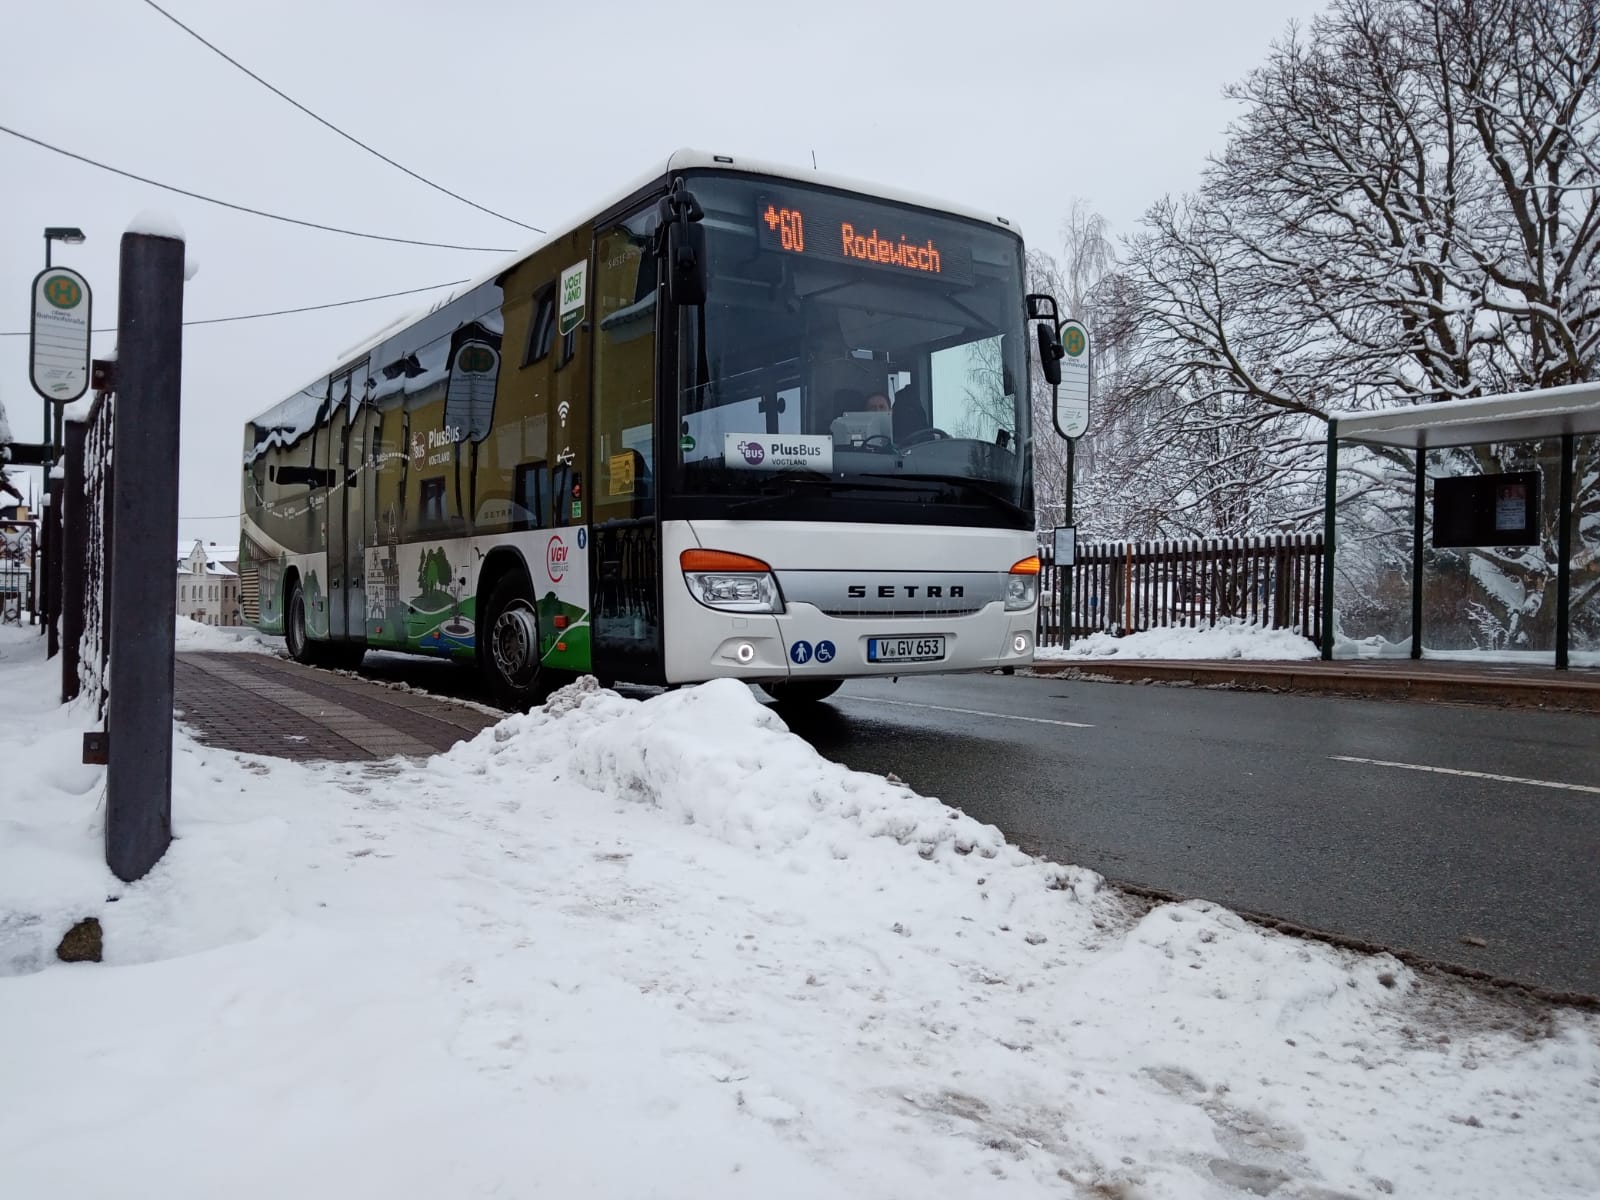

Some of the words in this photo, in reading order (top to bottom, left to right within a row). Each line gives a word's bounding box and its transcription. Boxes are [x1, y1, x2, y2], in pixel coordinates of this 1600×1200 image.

[841, 222, 941, 273] Rodewisch
[564, 271, 582, 290] VOGT
[564, 286, 582, 305] LAND
[428, 425, 460, 448] PlusBus
[745, 448, 764, 459] BUS
[771, 443, 821, 456] PlusBus
[771, 458, 808, 466] VOGTLAND
[551, 547, 569, 561] VGV
[848, 585, 964, 598] SETRA
[916, 639, 939, 655] 653
